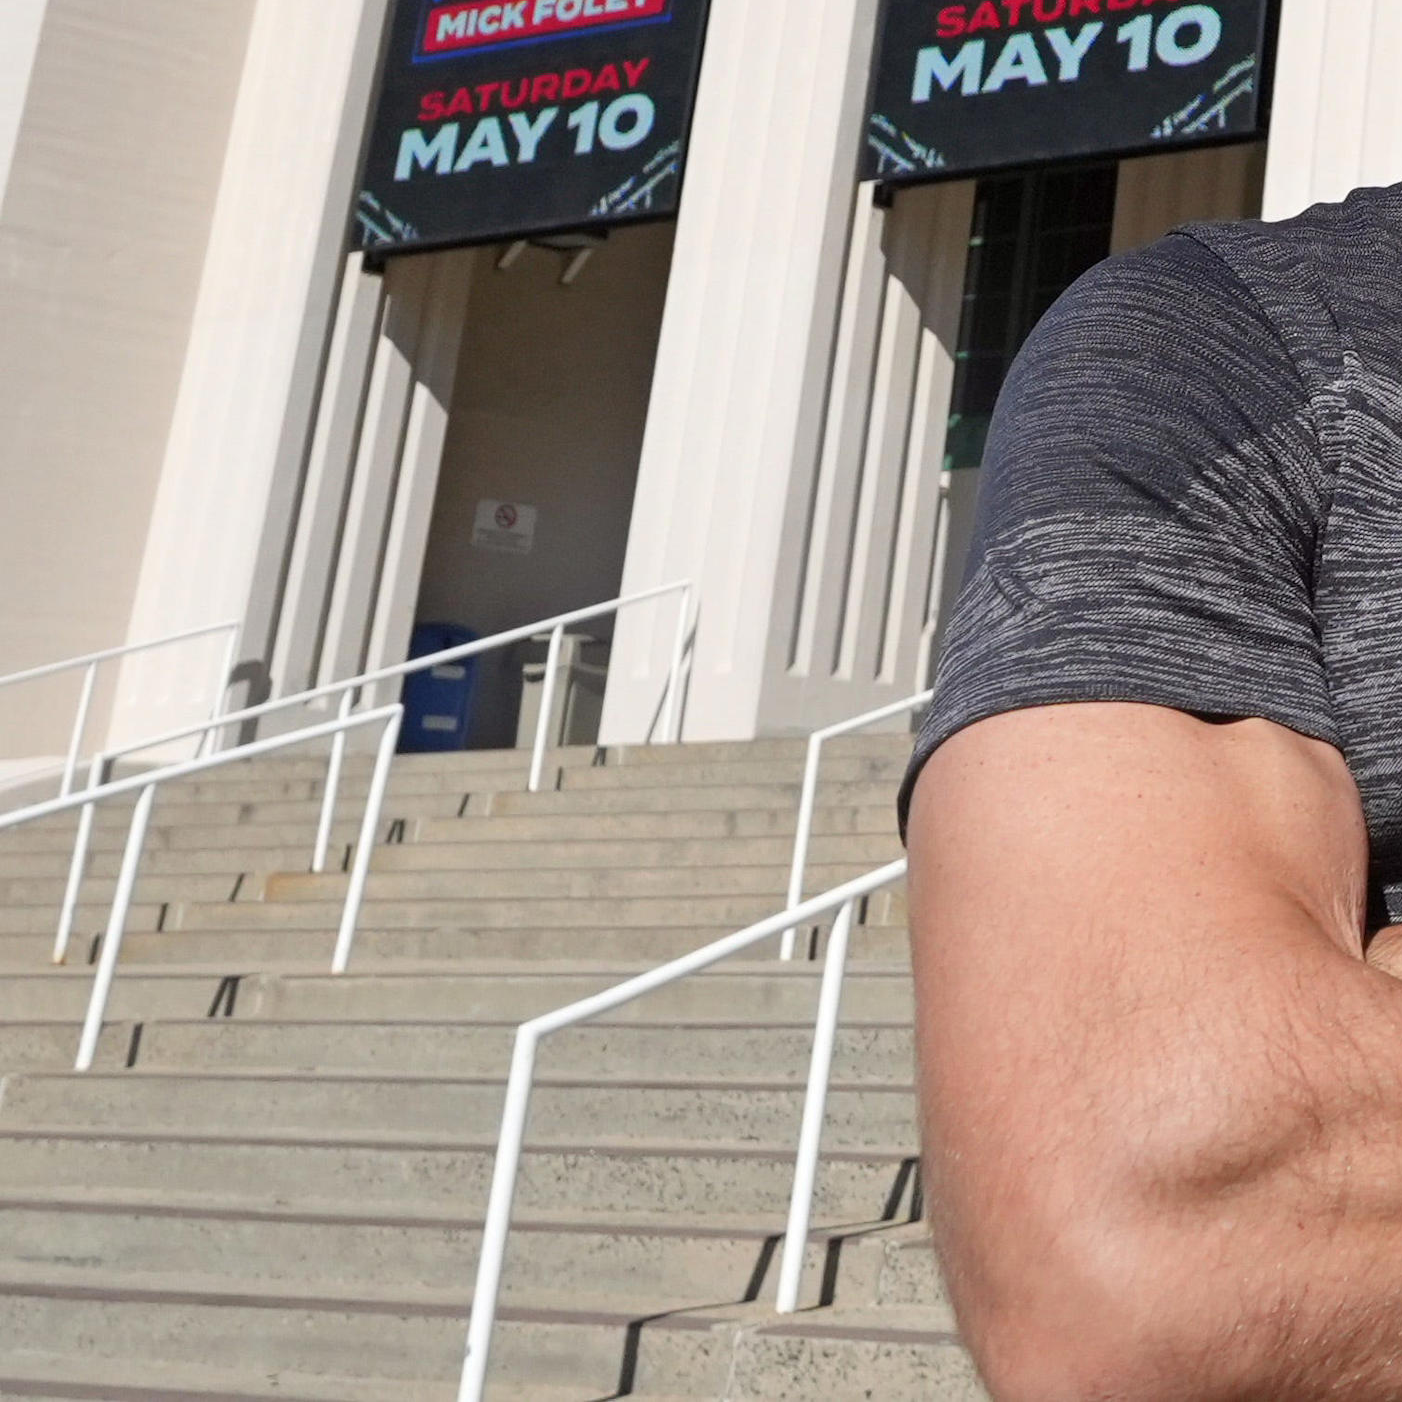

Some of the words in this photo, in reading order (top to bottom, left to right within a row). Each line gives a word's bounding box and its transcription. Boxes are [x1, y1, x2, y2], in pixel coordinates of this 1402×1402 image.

[436, 1, 526, 41] MICK
[911, 21, 1104, 104] MAY
[1117, 4, 1221, 72] 10
[418, 58, 649, 121] SATURDAY
[395, 106, 558, 181] MAY
[567, 93, 655, 155] 10
